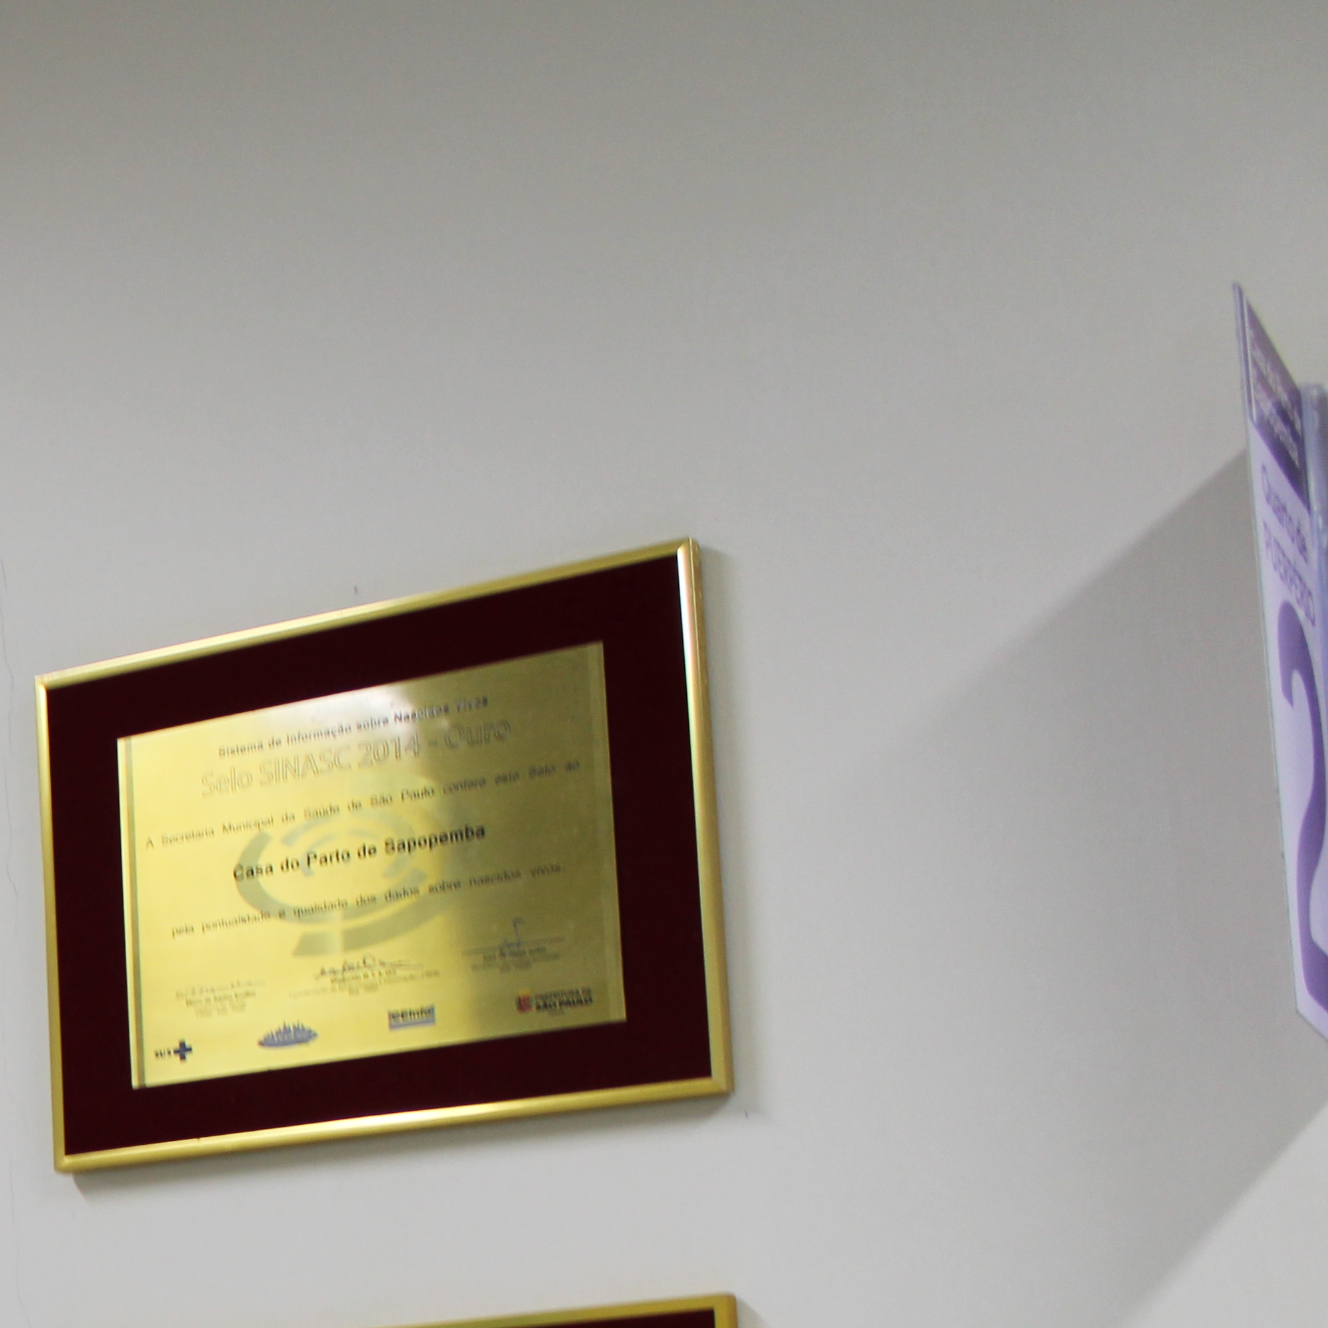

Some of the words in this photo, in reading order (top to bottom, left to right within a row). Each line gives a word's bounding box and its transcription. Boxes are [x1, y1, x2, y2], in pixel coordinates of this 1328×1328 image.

[200, 763, 253, 800] Selo
[258, 744, 352, 789] SINASC
[355, 731, 421, 771] 2014
[444, 713, 513, 754] Ouro
[217, 737, 263, 761] Sistema
[266, 733, 283, 751] de
[286, 719, 352, 747] Informação
[355, 712, 390, 734] sobre
[393, 700, 450, 727] Nascidos
[233, 857, 274, 885] Casa
[280, 853, 300, 877] do
[305, 844, 351, 872] Parto
[356, 839, 378, 863] de
[383, 820, 486, 859] Sapopemba
